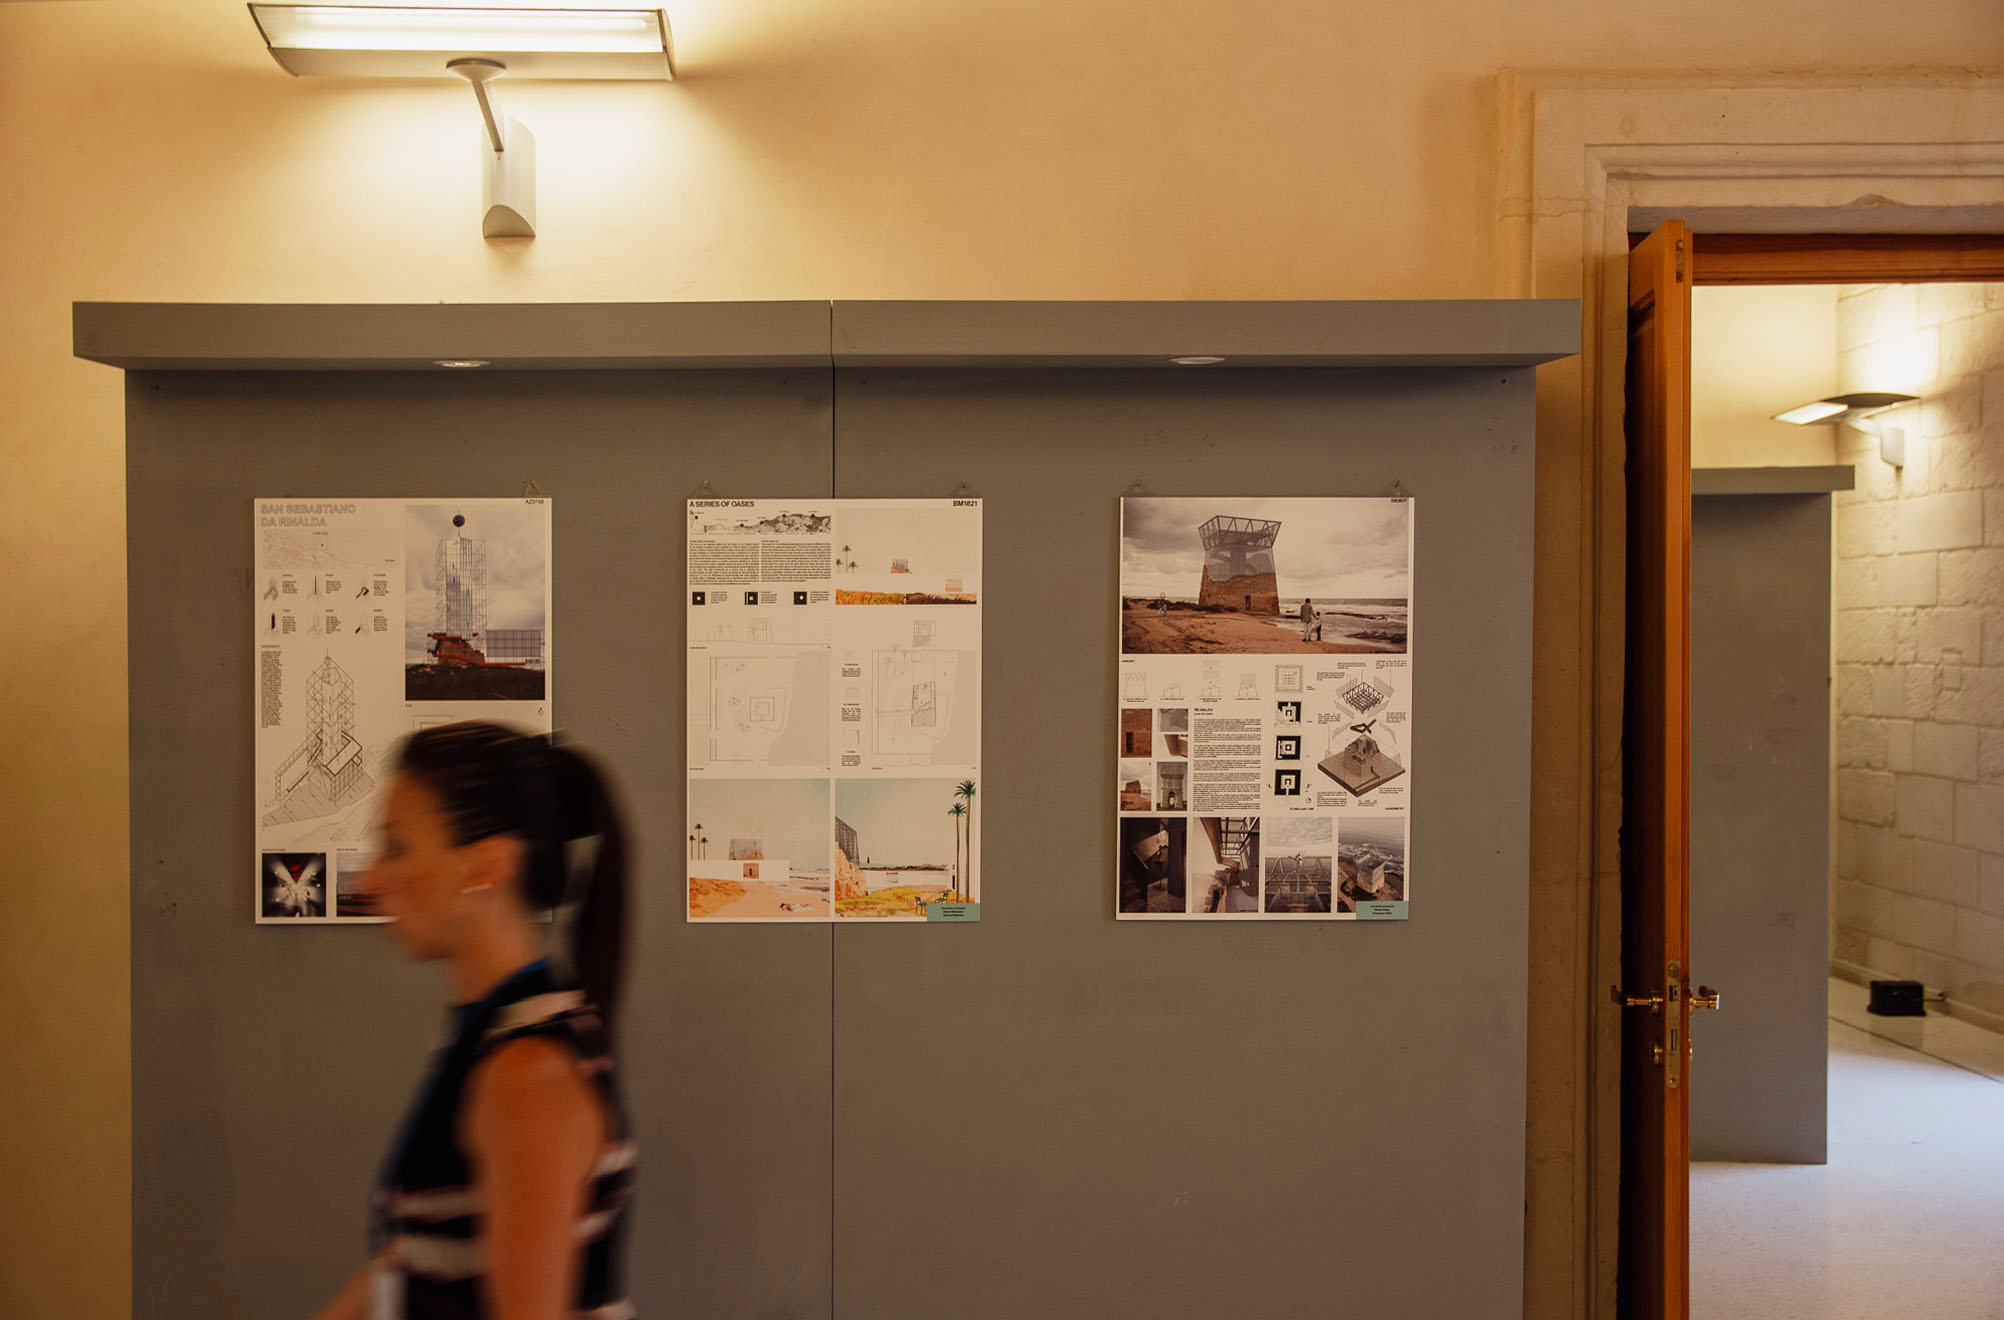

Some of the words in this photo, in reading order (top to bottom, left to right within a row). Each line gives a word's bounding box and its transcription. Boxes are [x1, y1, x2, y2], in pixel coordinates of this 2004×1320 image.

[260, 503, 284, 514] SAN
[286, 503, 357, 514] SEBASTIANO
[260, 516, 277, 527] DA
[278, 516, 328, 527] RINALDA
